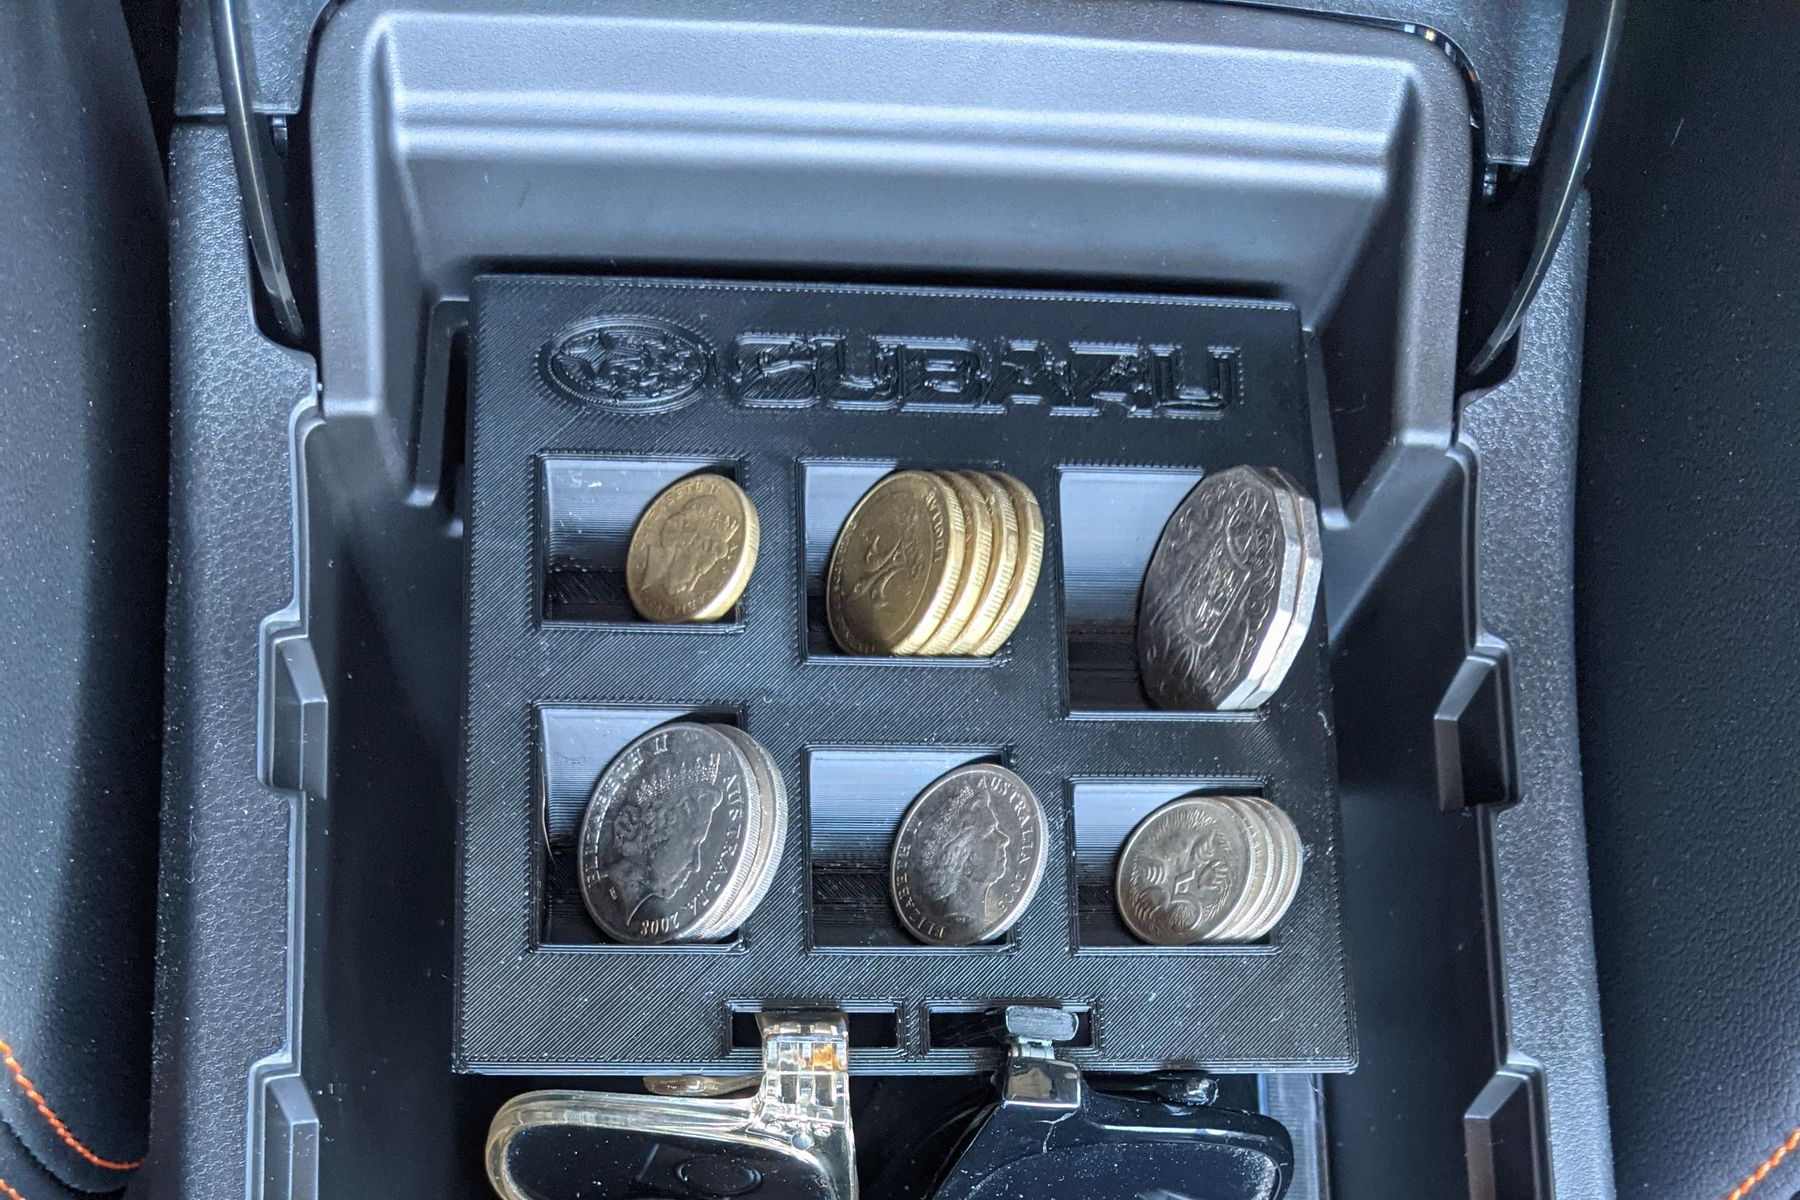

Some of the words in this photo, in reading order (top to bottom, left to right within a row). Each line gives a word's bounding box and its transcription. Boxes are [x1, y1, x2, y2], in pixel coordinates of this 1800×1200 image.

[730, 329, 1242, 418] SUBARU
[686, 773, 743, 916] AUSTRALIA
[976, 775, 1035, 866] AUSTRALIA
